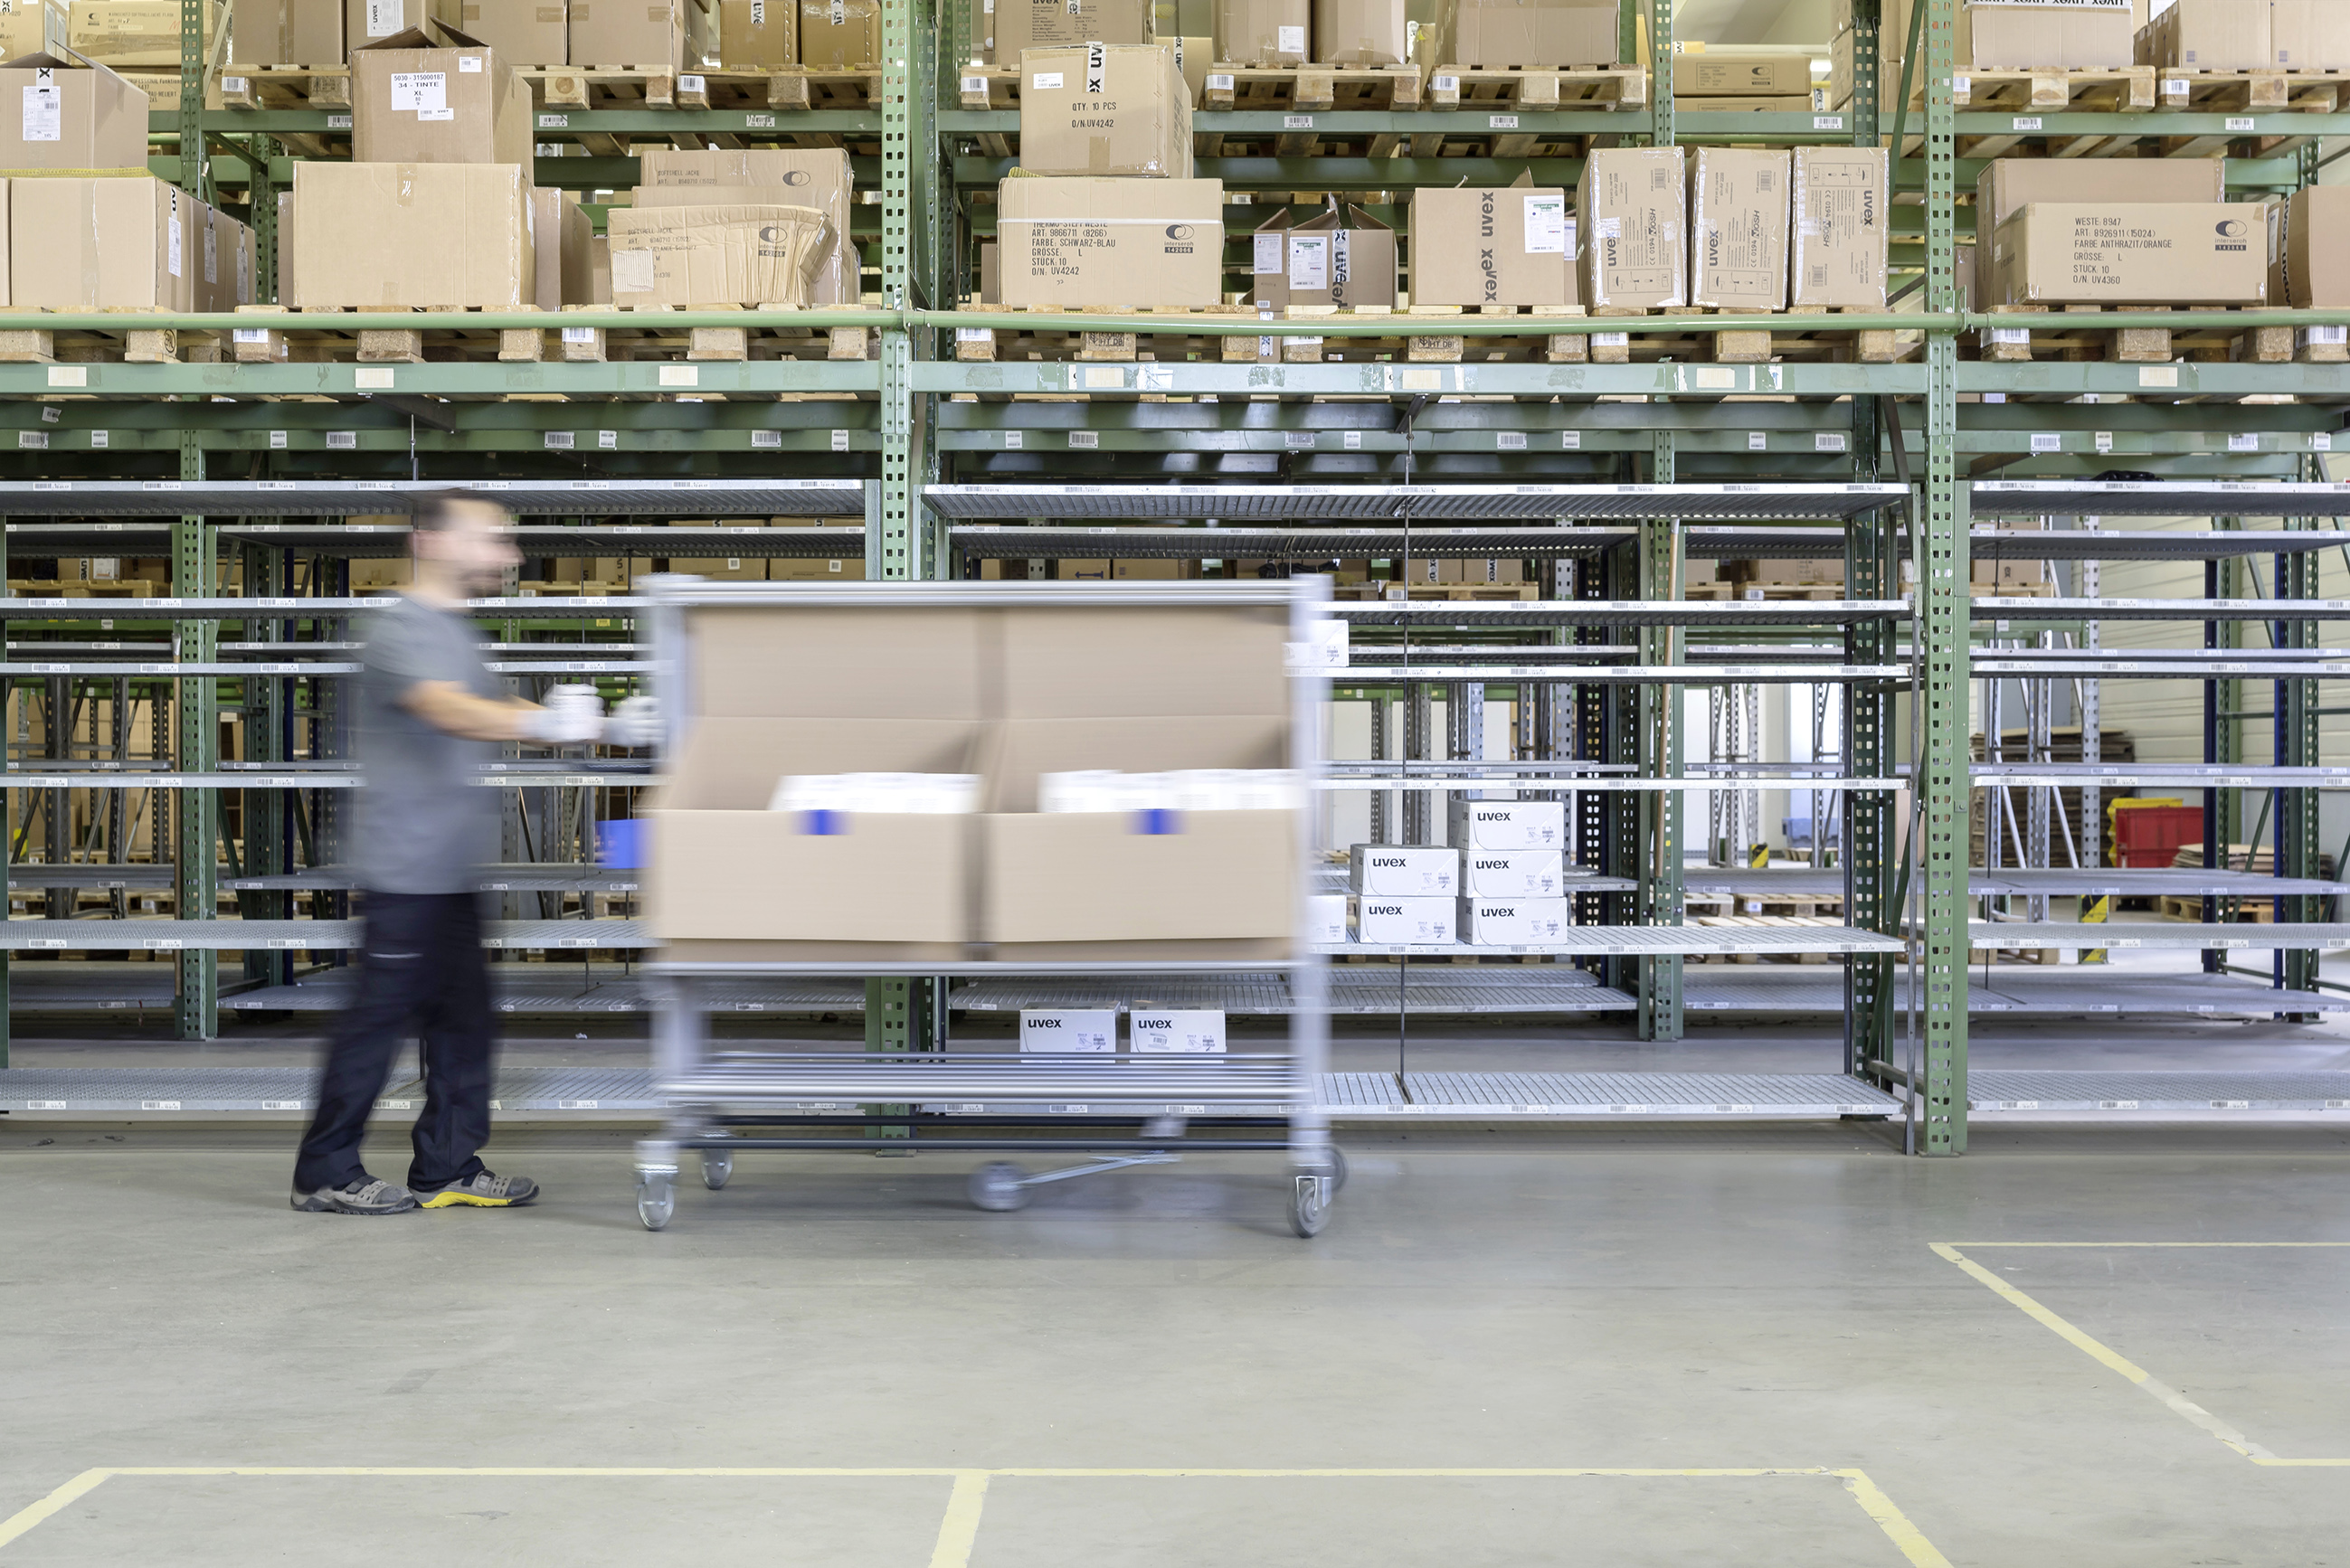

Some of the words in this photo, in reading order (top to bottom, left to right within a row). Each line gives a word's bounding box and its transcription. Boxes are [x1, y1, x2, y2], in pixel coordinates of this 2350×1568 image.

[1072, 103, 1088, 111] QTY:
[1093, 103, 1099, 111] 10
[1103, 102, 1116, 110] PCS
[1864, 190, 1873, 226] uvex
[1481, 192, 1493, 237] uvex
[1083, 229, 1107, 237] (8266)
[1060, 239, 1116, 247] SCHWARZ-BLAU
[2075, 240, 2097, 248] FARBE
[2101, 240, 2172, 248] ANTHRAZIT/ORANGE
[1078, 248, 1082, 256] L
[1709, 230, 1718, 266] uvex
[1051, 267, 1079, 275] UV4242
[2092, 276, 2121, 284] UV4360
[1478, 812, 1510, 821] uvex
[1372, 857, 1406, 867] uvex
[1476, 860, 1509, 869] uvex
[1368, 906, 1402, 915] uvex
[1481, 908, 1515, 917] uvex
[1028, 1019, 1061, 1028] uvex
[1138, 1019, 1172, 1029] uvex
